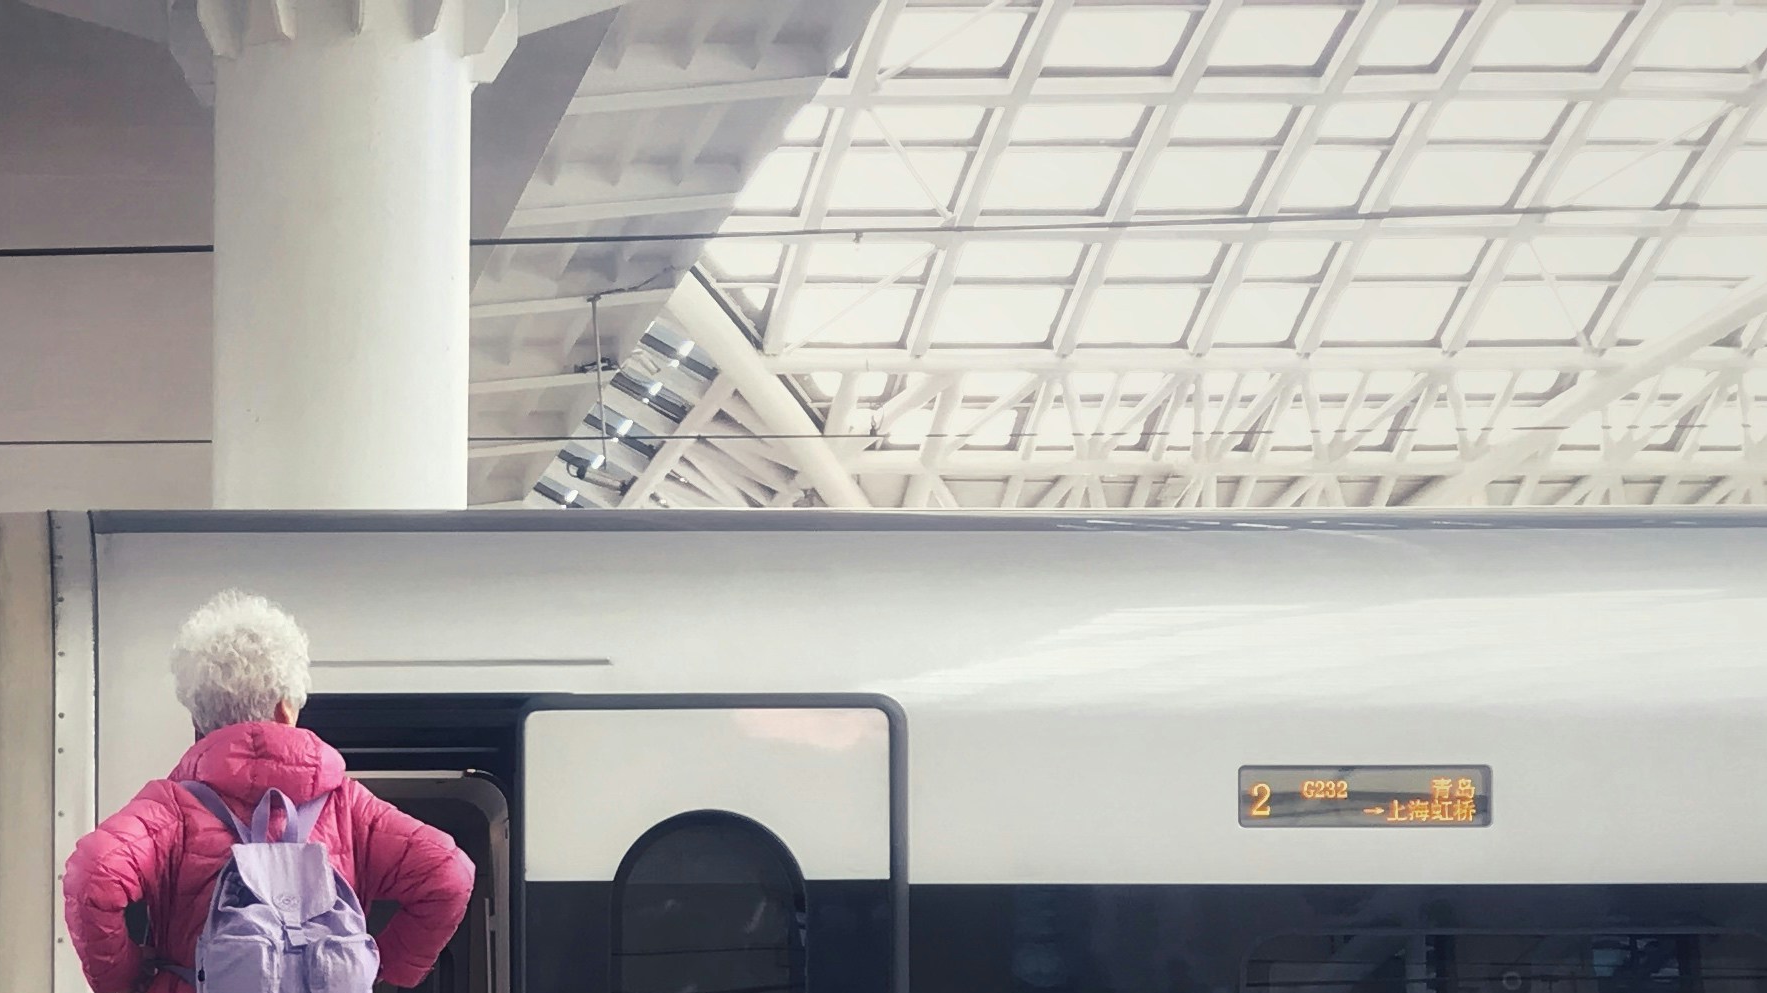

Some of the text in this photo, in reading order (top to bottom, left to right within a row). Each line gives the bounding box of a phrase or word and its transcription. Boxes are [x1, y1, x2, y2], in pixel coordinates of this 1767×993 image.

[1302, 781, 1348, 798] G232
[1433, 778, 1475, 799] 青岛
[1252, 783, 1271, 816] 2
[1387, 800, 1475, 822] 上海虹桥
